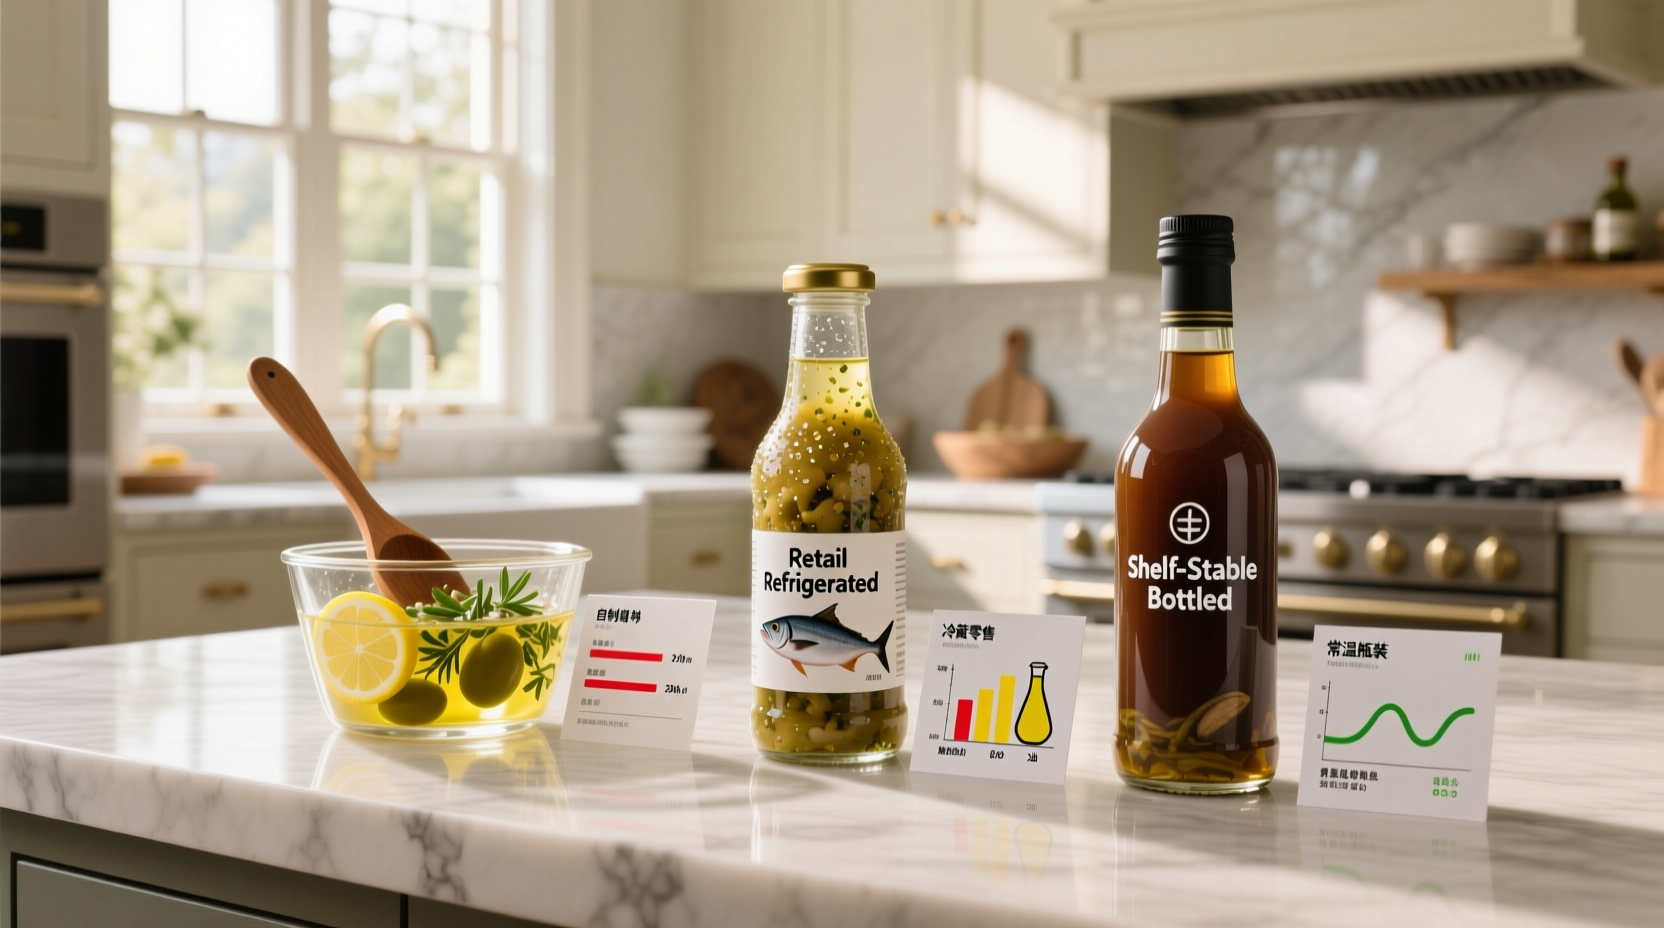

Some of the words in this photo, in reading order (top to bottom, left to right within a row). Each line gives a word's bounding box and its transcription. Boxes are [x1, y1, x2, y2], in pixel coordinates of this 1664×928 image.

[789, 547, 847, 568] Retail
[1127, 554, 1258, 580] Shelf-Stable
[764, 571, 879, 598] Refrigerated
[1147, 585, 1233, 611] Bottled
